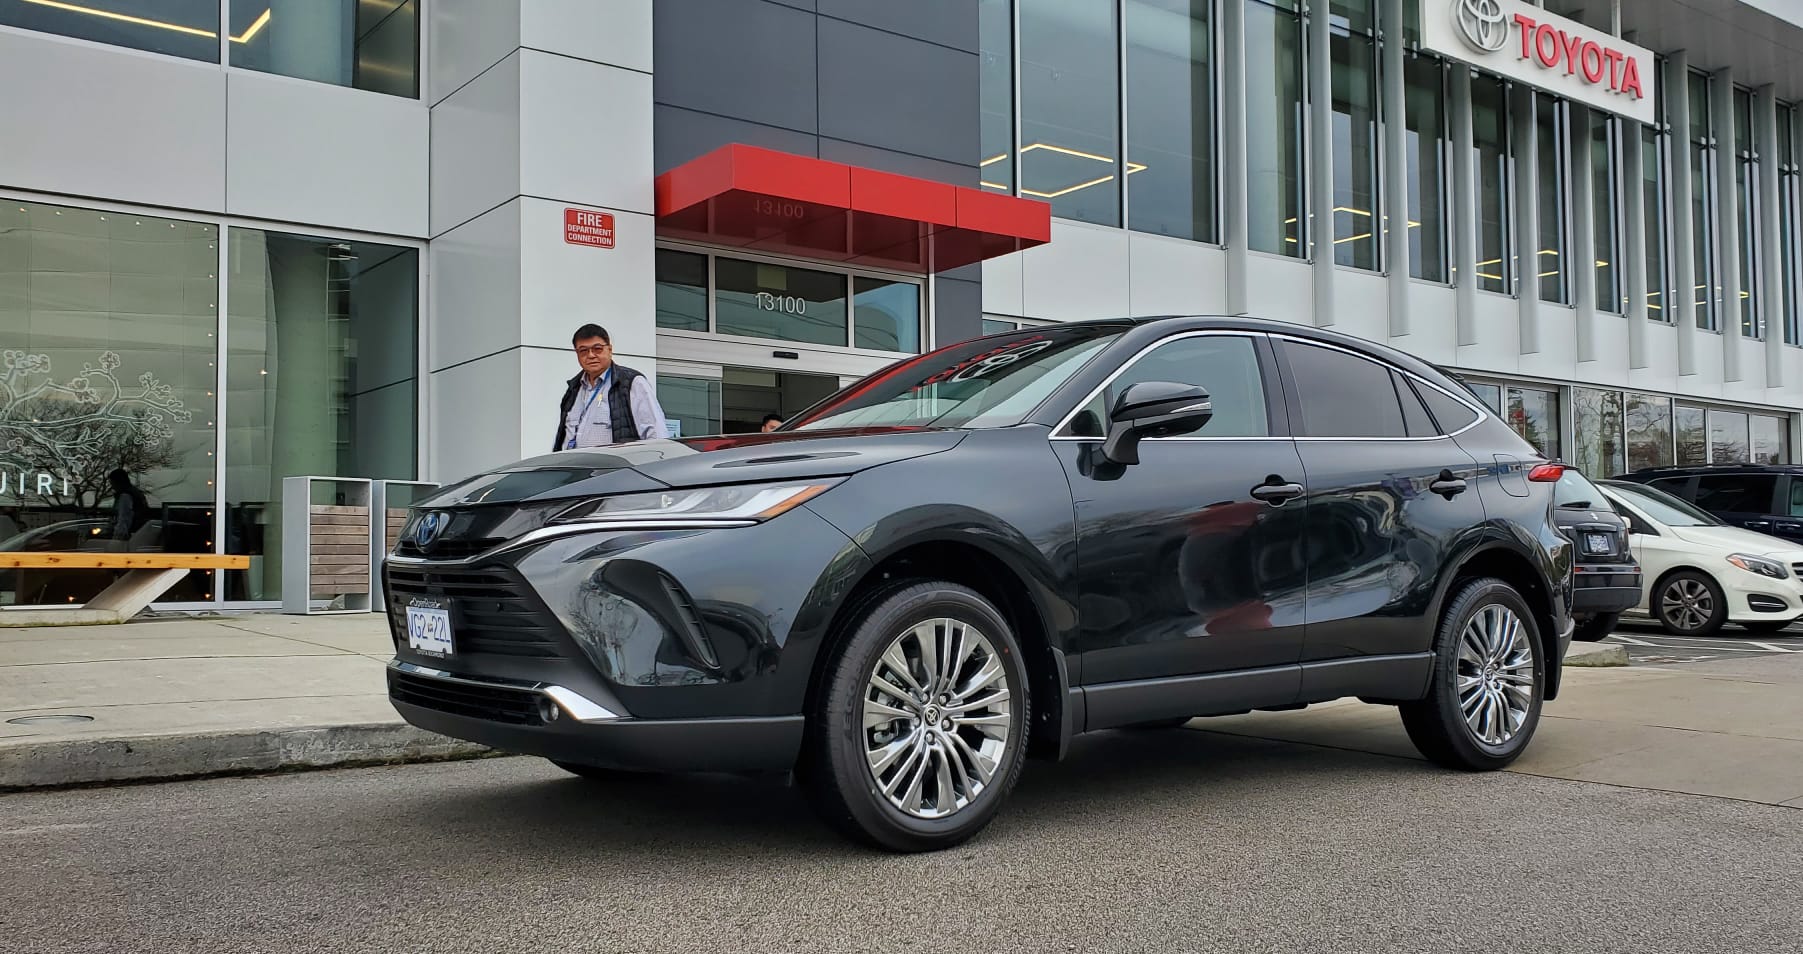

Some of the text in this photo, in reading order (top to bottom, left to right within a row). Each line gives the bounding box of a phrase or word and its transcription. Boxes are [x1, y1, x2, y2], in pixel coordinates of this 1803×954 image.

[1514, 13, 1643, 99] TOYOTA
[577, 212, 603, 227] FIRE
[568, 224, 612, 237] DEPARTMENT
[568, 232, 612, 245] CONNECTION
[755, 293, 806, 315] 13100
